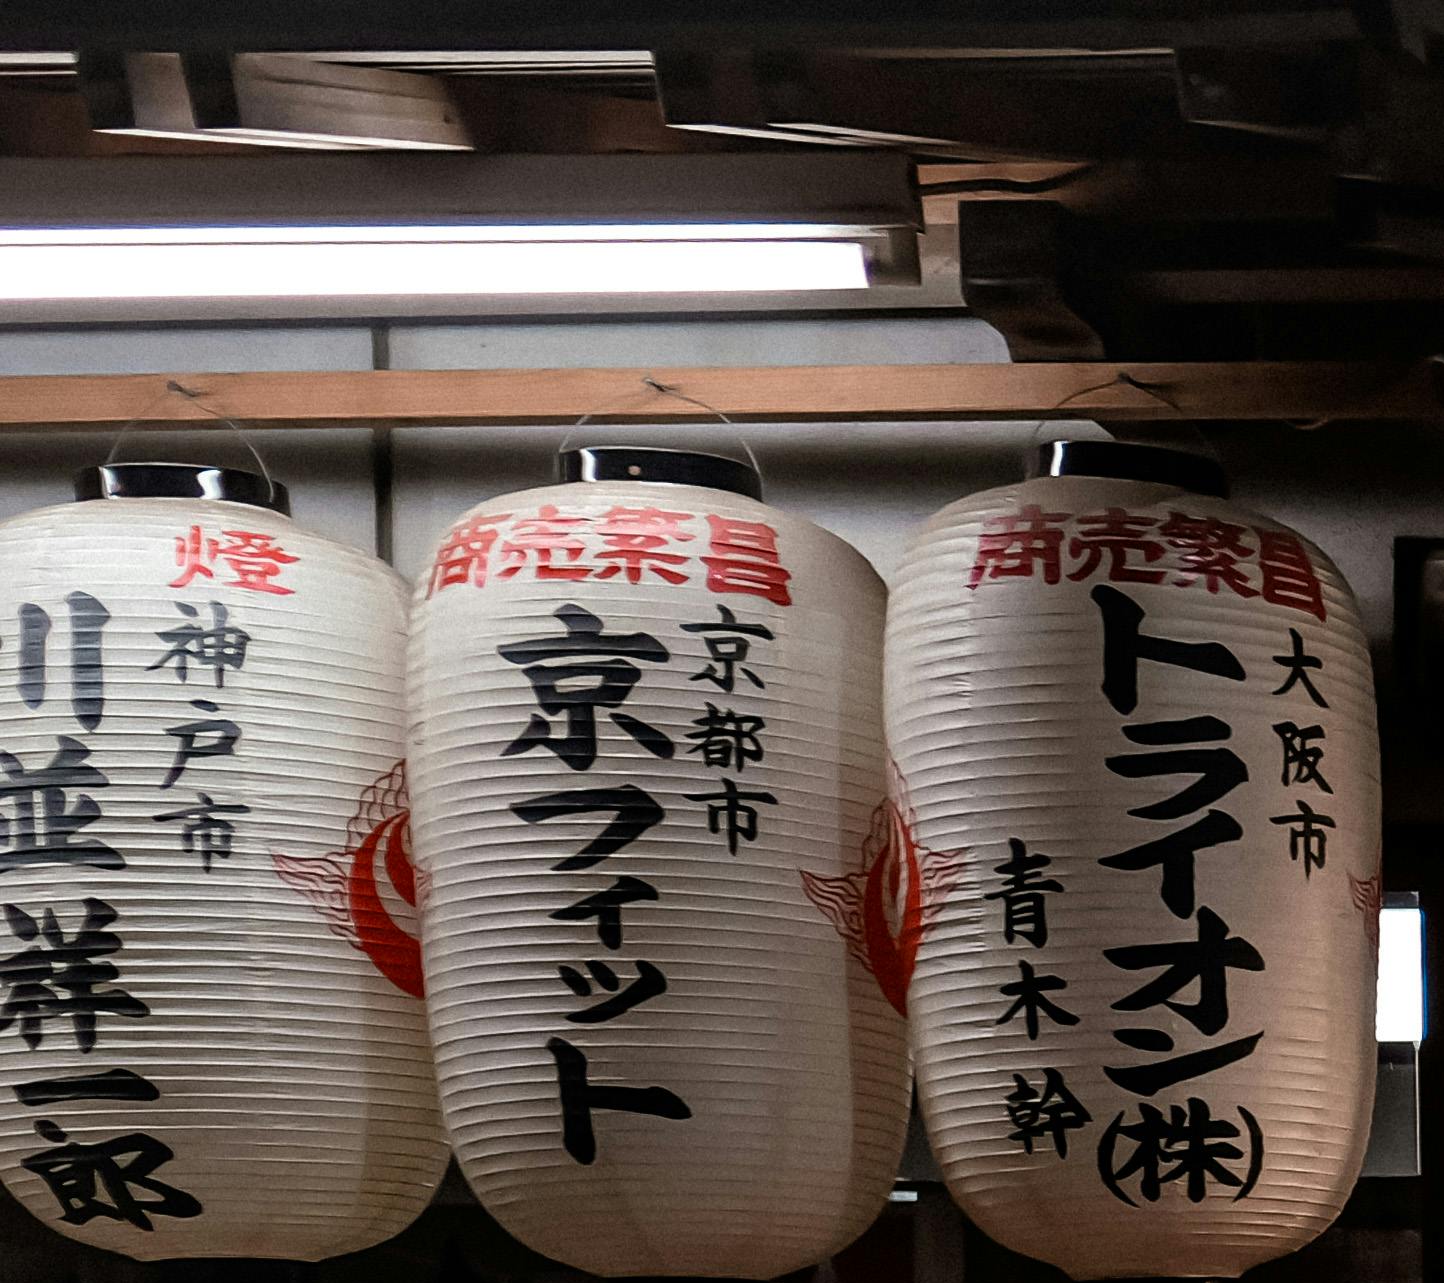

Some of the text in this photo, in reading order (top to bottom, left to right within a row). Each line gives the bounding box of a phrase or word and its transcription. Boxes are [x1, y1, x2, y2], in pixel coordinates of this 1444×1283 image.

[426, 504, 793, 608] 商売繁昌
[965, 506, 1325, 622] 商売繁昌
[147, 602, 251, 876] 神戸市
[680, 606, 775, 858] 京都市
[1266, 629, 1339, 880] 大阪市
[496, 602, 693, 1166] 京フィット
[983, 840, 1090, 1159] 青木幹
